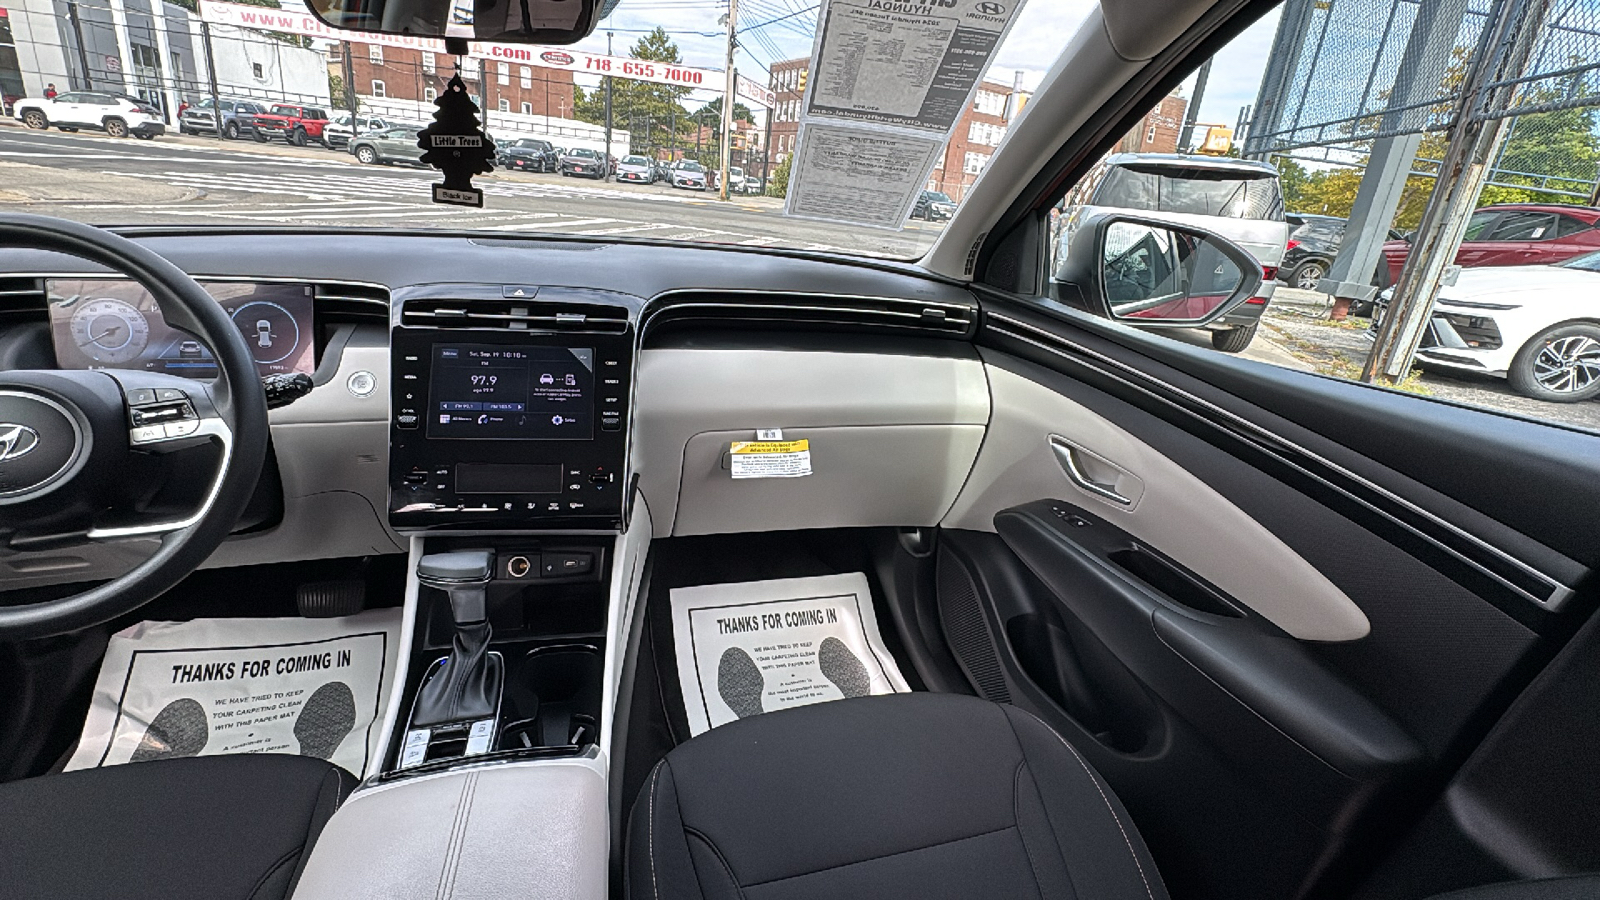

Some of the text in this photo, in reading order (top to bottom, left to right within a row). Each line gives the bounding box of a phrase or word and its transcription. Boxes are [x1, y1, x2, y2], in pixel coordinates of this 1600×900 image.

[434, 137, 479, 146] Little Trees
[442, 191, 473, 201] Black Ice
[471, 375, 497, 385] 97.9
[717, 608, 838, 635] THANKS FOR COMING IN
[172, 650, 351, 683] THANKS FOR COMING IN
[251, 694, 272, 702] TRIED
[285, 689, 304, 697] KEEP
[212, 700, 302, 719] YOUR CARPETING CLEAN
[215, 711, 295, 731] WITH THIS PAPER MAT
[266, 744, 290, 752] person
